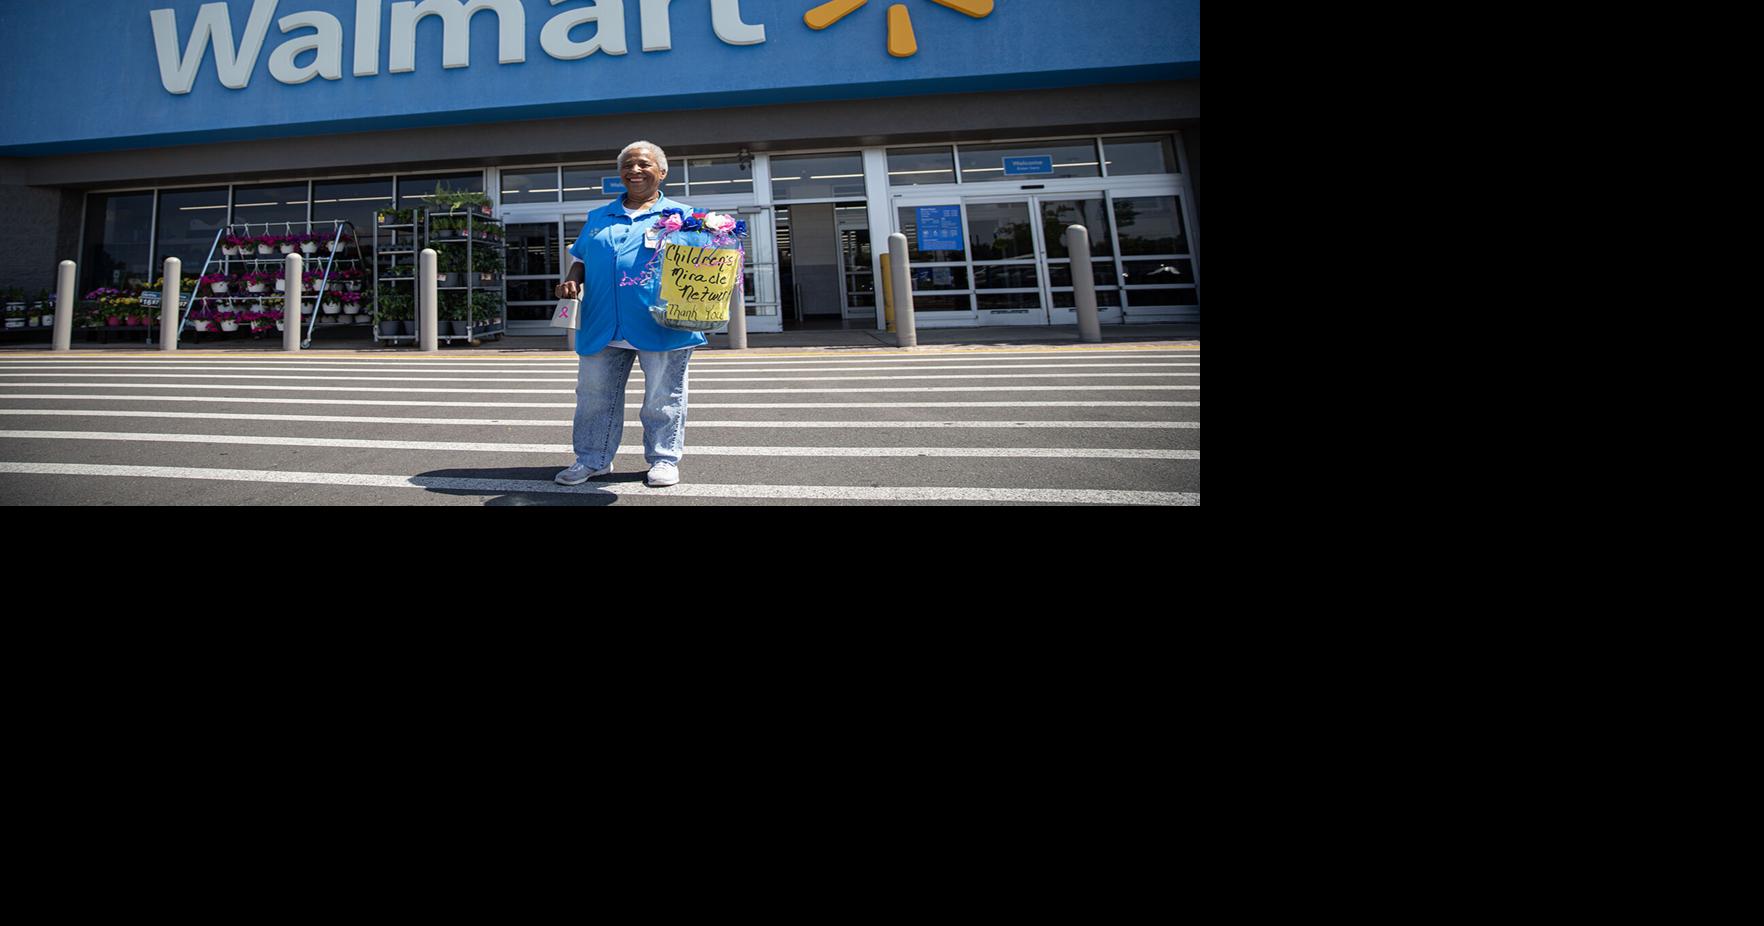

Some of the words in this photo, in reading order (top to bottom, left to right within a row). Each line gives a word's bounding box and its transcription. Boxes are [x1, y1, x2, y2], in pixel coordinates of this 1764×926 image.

[150, 0, 766, 94] Walmart
[666, 244, 733, 272] Children's
[668, 303, 698, 321] Thank
